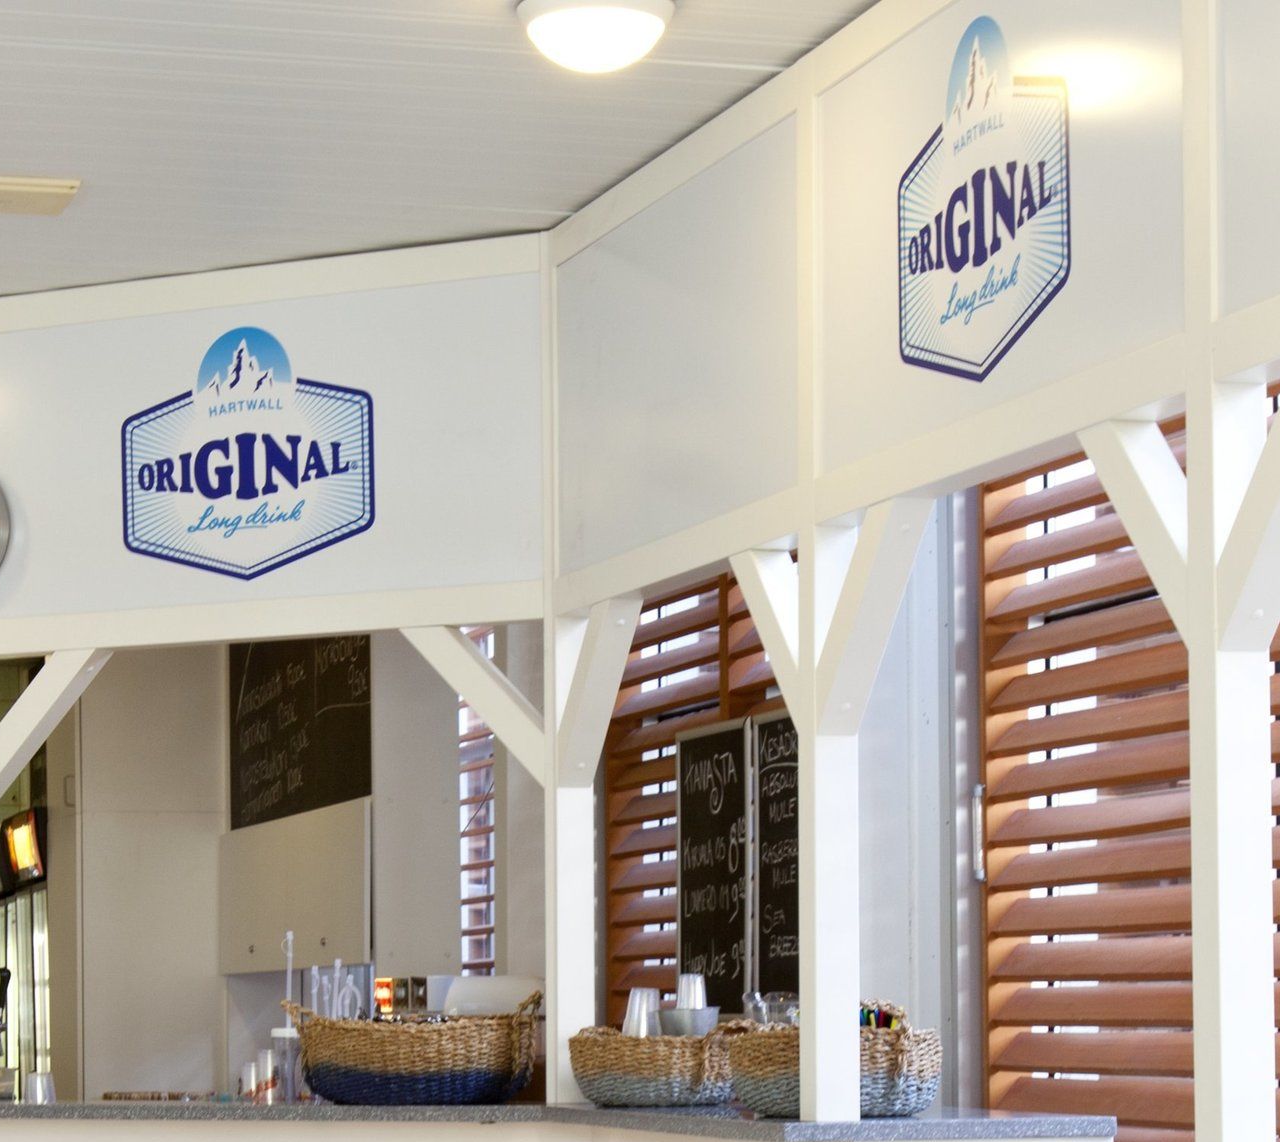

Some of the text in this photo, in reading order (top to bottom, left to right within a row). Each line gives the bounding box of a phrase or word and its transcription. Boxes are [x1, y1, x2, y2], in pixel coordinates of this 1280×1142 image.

[952, 112, 1005, 156] HARTWALL
[908, 160, 1054, 275] ORIGINAL
[940, 253, 1020, 325] Long drink
[208, 397, 284, 417] HARTWALL
[137, 432, 350, 500] ORIGINAL
[187, 498, 306, 539] Long drink
